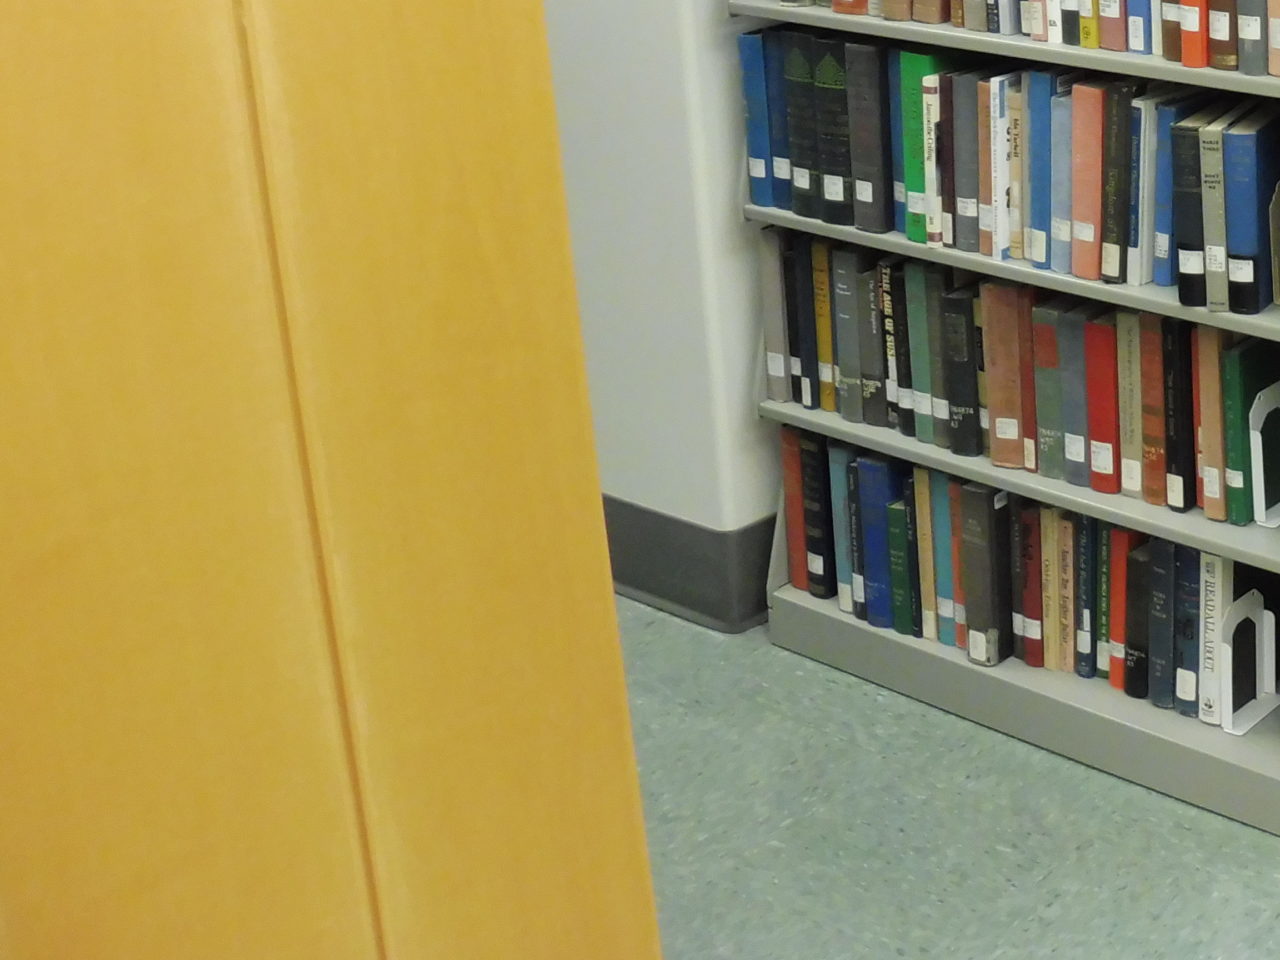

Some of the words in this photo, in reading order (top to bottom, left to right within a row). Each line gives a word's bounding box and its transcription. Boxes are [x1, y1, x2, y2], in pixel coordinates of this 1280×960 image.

[882, 267, 892, 291] THE
[883, 293, 893, 316] AGE
[1205, 580, 1216, 614] READ
[1205, 612, 1215, 635] ALL
[1204, 639, 1214, 672] ABOUT
